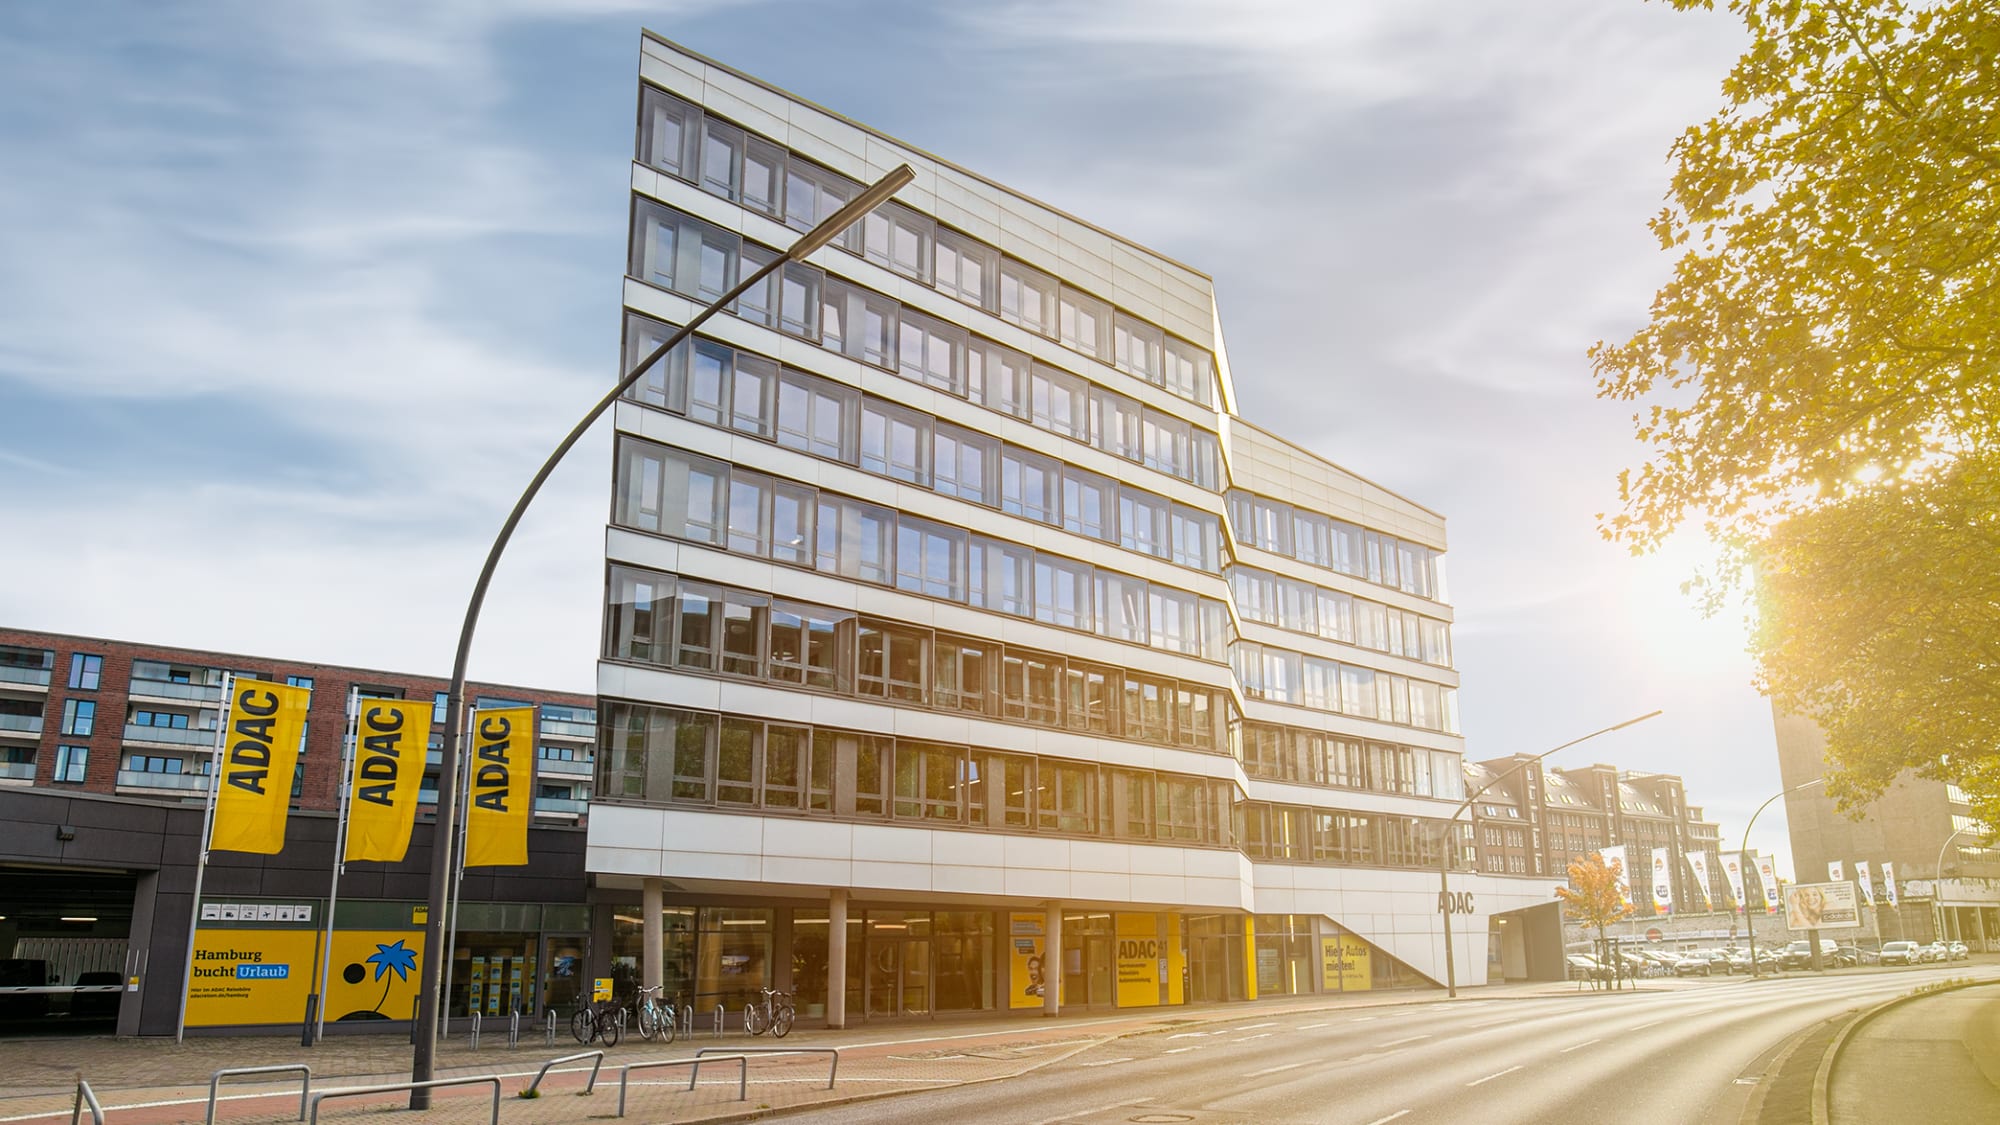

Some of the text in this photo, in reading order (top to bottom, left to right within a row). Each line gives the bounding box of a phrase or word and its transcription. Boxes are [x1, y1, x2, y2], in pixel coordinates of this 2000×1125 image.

[228, 689, 279, 795] ADAC
[358, 707, 404, 807] ADAC
[475, 717, 511, 813] ADAC
[1438, 891, 1474, 914] ADAC
[195, 949, 262, 962] Hamburg
[1118, 940, 1156, 959] ADAC
[1325, 945, 1367, 957] Hier Autos
[194, 966, 286, 977] bucht Urlaub
[1326, 960, 1355, 971] mieten!
